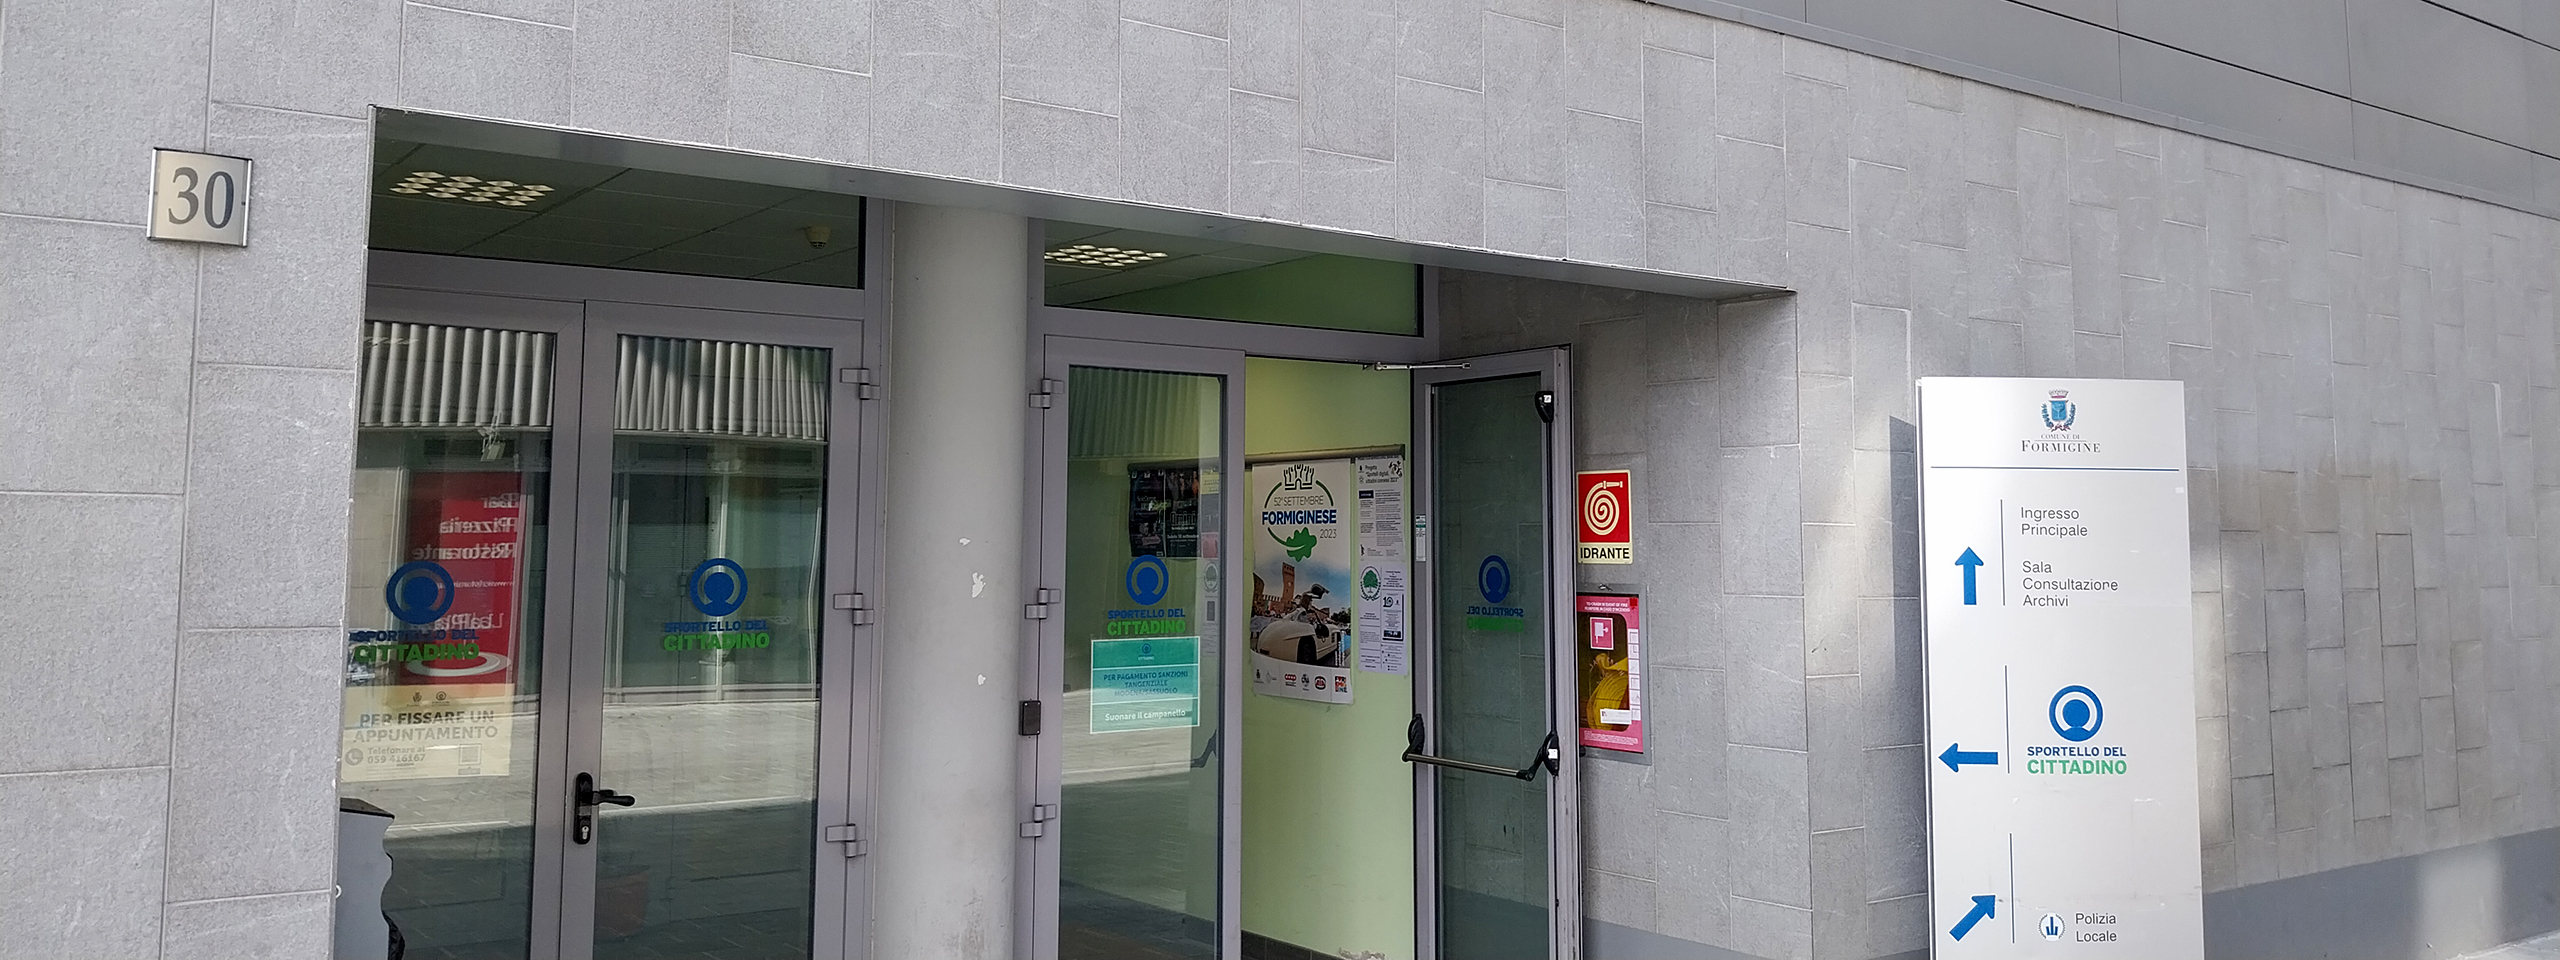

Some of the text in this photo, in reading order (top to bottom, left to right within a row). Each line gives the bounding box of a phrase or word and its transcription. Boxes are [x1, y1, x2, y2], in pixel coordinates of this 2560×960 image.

[167, 166, 235, 230] 30
[2021, 439, 2101, 454] FORMIGINE
[1284, 495, 1324, 506] SETTEMBRE
[1262, 509, 1337, 525] FORMIGINESE
[2020, 506, 2080, 522] Ingresso
[1320, 529, 1337, 539] 2023
[2021, 523, 2088, 539] Principale
[1580, 547, 1630, 559] IDRANTE
[2022, 560, 2053, 574] Sala
[2022, 577, 2119, 591] Consultazione
[2022, 594, 2069, 607] Archivi
[1108, 608, 1186, 620] SPORTELLO DEL
[664, 620, 769, 633] SPORTELLO DEL
[1107, 620, 1187, 636] CITTADINO
[451, 628, 480, 640] DEL
[664, 632, 770, 652] CITTADINO
[354, 643, 480, 663] CITTADINO
[1117, 672, 1156, 680] PAGAMENTO
[1158, 671, 1188, 679] SANZIONI
[1125, 680, 1168, 688] TANGENZIALE
[360, 710, 494, 728] PER FISSARE UN
[1105, 713, 1136, 722] Suonare
[1144, 709, 1186, 720] campanello
[353, 726, 498, 743] APPUNTAMENTO
[2027, 746, 2127, 757] SPORTELLO DEL
[367, 755, 387, 764] 059
[2027, 760, 2127, 775] CITTADINO
[2075, 912, 2116, 925] Polizia
[2076, 931, 2117, 943] Locale
